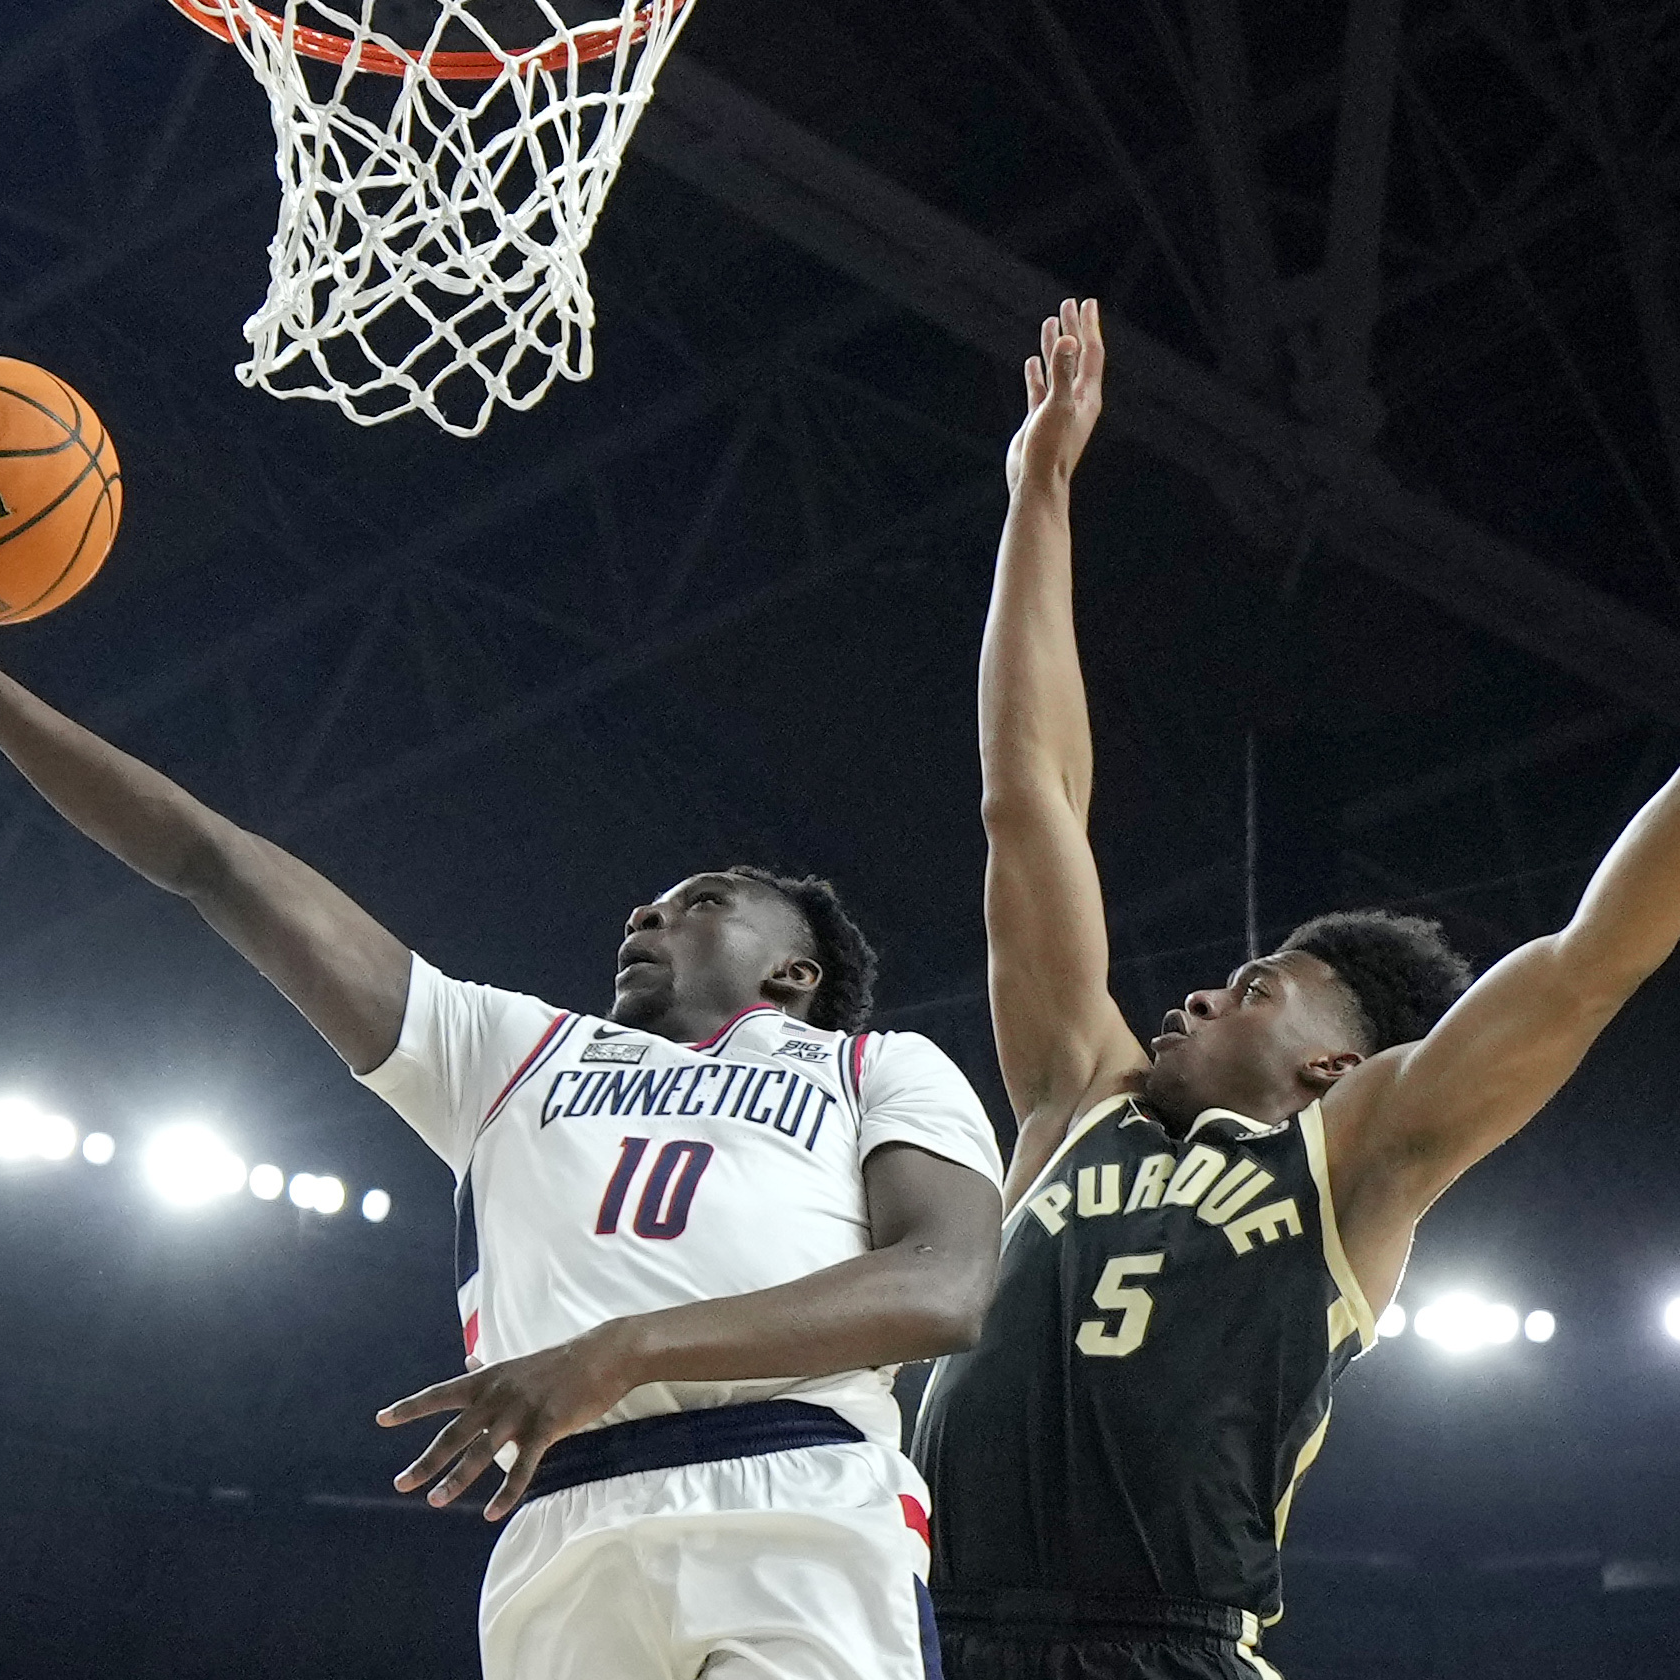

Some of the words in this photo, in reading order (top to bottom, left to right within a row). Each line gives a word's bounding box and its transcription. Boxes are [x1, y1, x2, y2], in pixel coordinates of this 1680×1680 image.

[777, 1047, 832, 1061] EAST
[785, 1039, 824, 1052] BIG
[540, 1063, 837, 1152] CONNECTICUT
[594, 1136, 714, 1240] 10
[1025, 1142, 1304, 1258] PURDUE
[1074, 1251, 1166, 1359] 5
